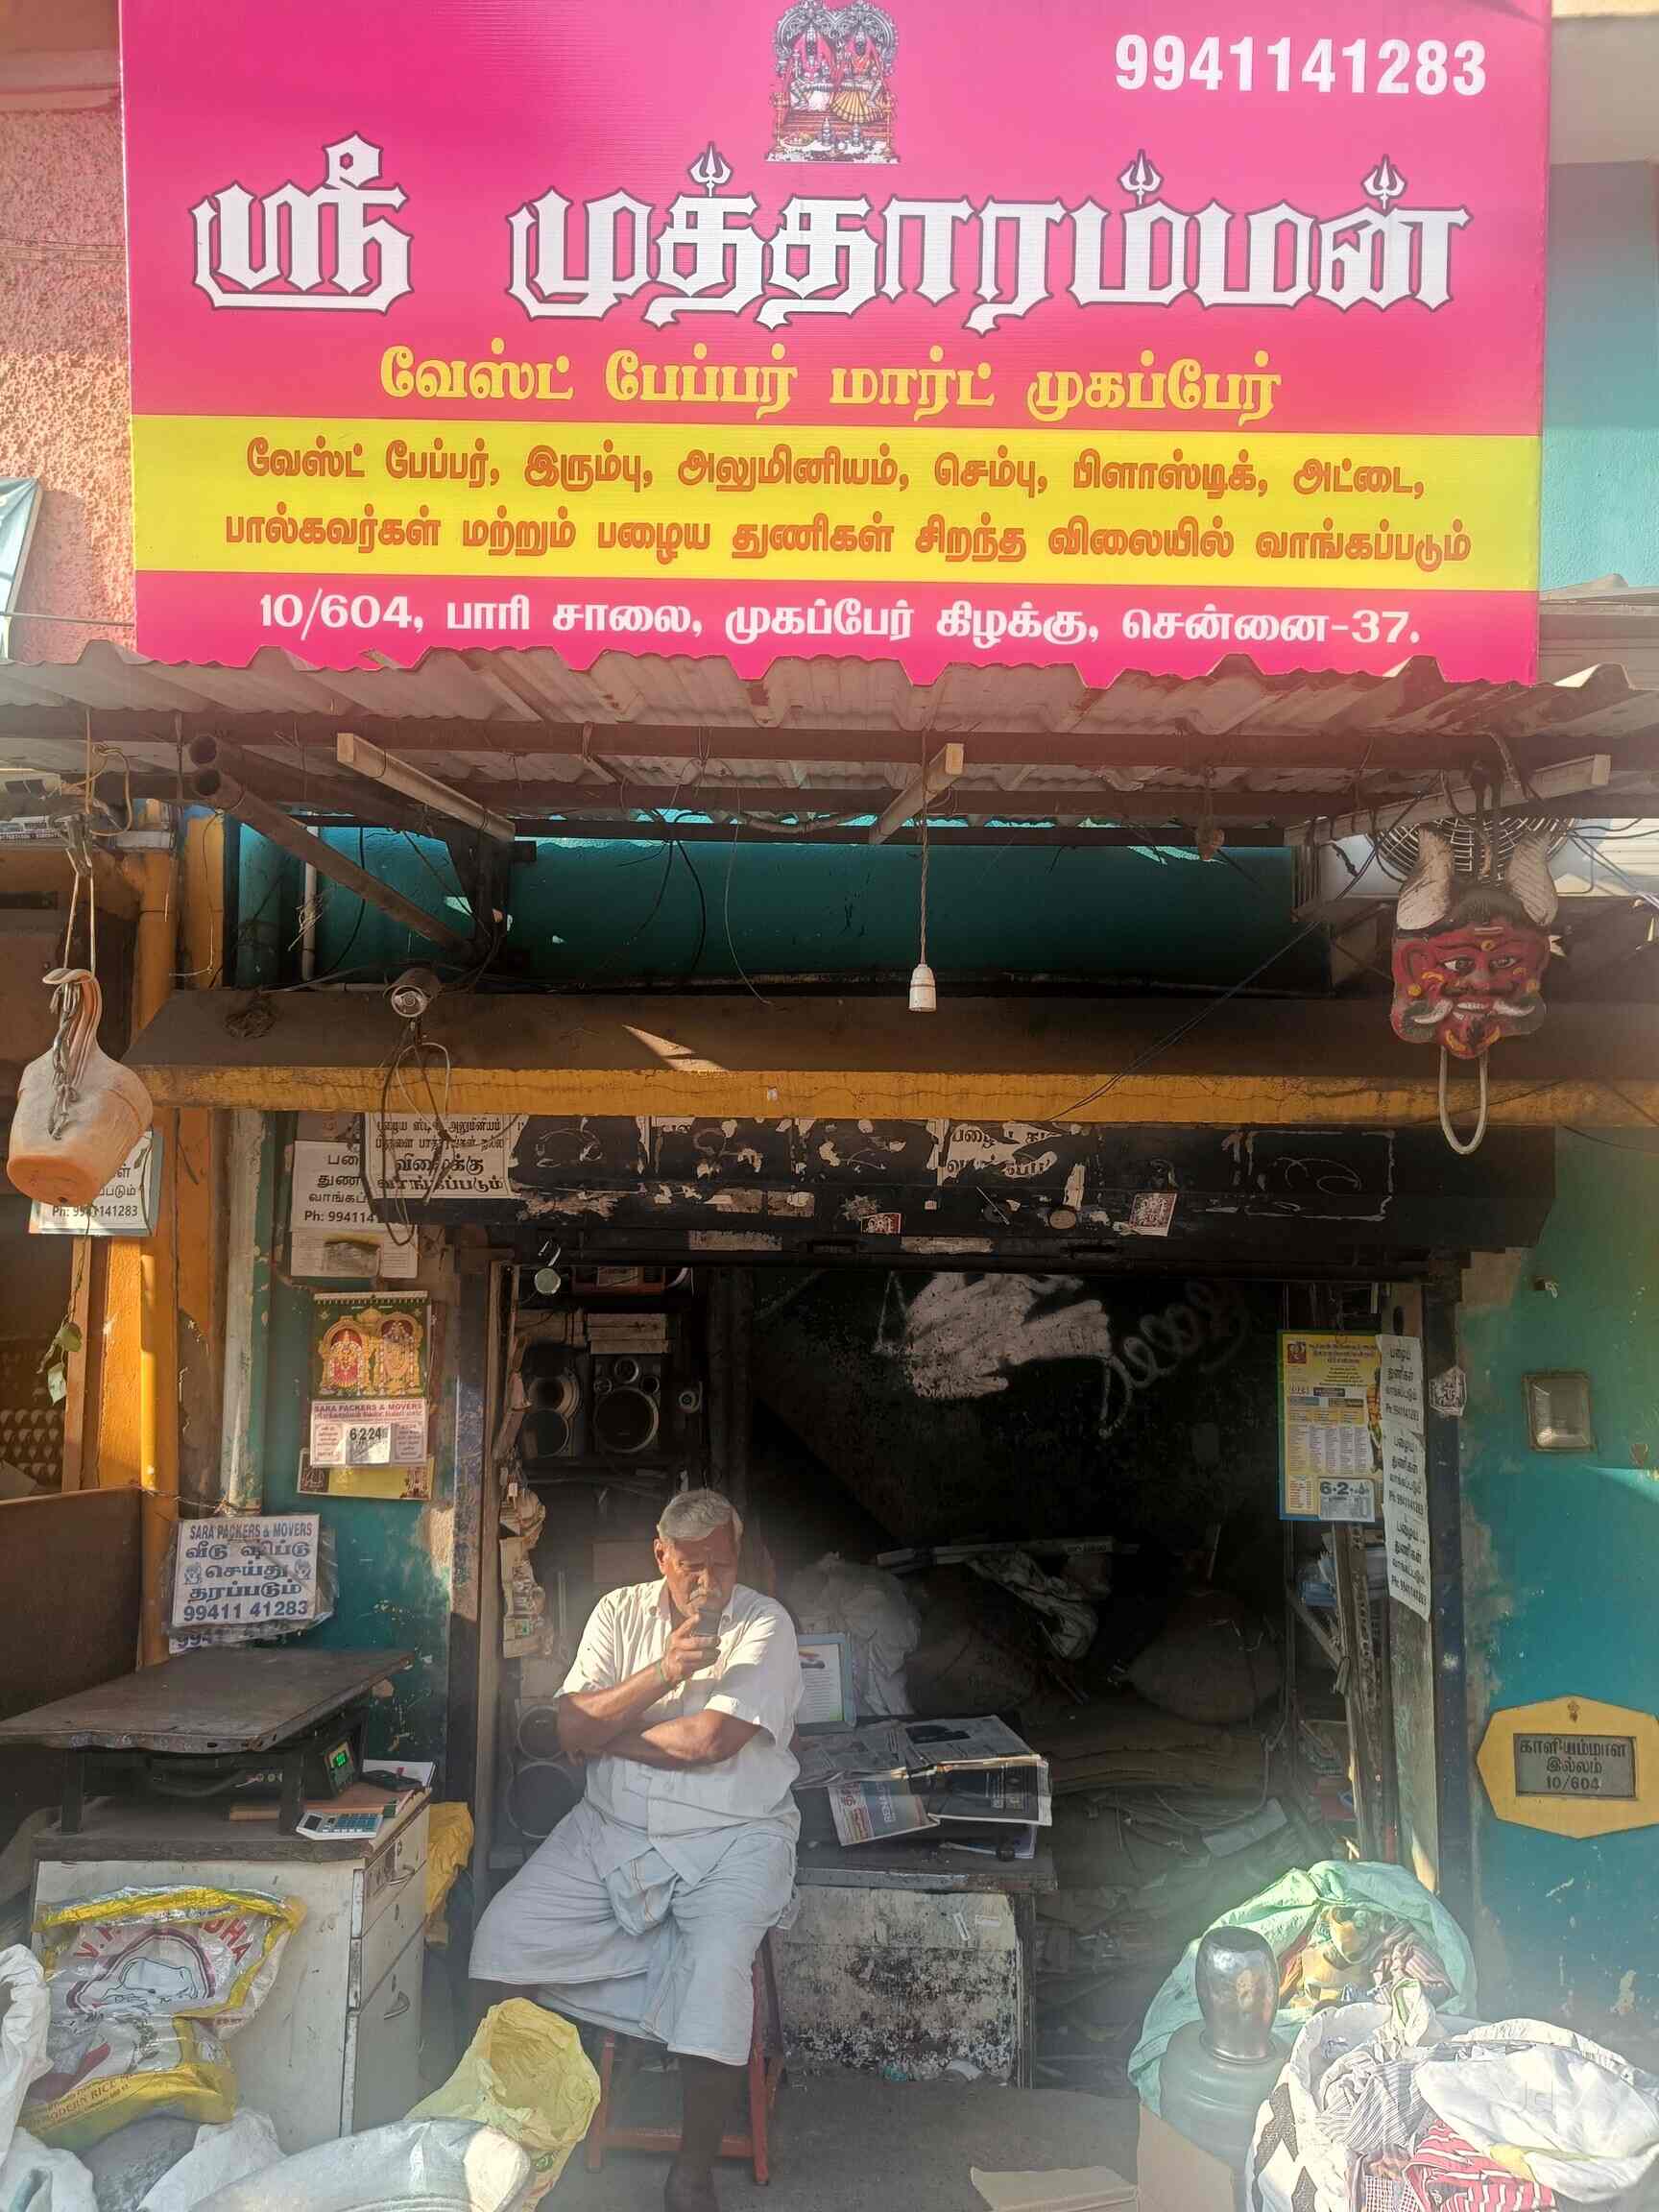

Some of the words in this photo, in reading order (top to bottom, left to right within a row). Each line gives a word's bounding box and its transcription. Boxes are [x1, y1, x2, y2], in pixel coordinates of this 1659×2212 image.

[1114, 34, 1486, 96] 9941141283
[506, 141, 1473, 337] முத்தாரம்மன்
[381, 338, 573, 401] வேஸ்ட்
[605, 343, 798, 420] பேப்பர்
[830, 345, 995, 421] மார்ட்
[1026, 349, 1282, 426] முகப்பேர்
[246, 436, 365, 479] வேஸ்ட்
[386, 438, 500, 488] பேப்பர்,
[524, 440, 655, 493] இரும்பு,
[678, 443, 910, 492] அலுமினியம்,
[934, 445, 1048, 498] செம்பு,
[1072, 448, 1268, 499] பிளாஸ்டிக்,
[1293, 458, 1425, 499] அட்டை,
[226, 504, 441, 554] பால்கவர்கள்
[462, 505, 576, 557] மற்றும்
[597, 520, 710, 565] பழைய
[732, 510, 894, 559] துணிகள்
[915, 512, 1026, 563] சிறந்த
[1048, 516, 1234, 559] விலையில்
[1255, 518, 1471, 571] வாங்கப்படும்
[260, 588, 423, 641] 10/604,
[445, 593, 530, 631] பாரி
[552, 602, 703, 637] சாலை,
[725, 597, 913, 645] முகப்பேர்
[936, 601, 1098, 650] கிழக்கு,
[1121, 602, 1420, 645] சென்னை-37.
[305, 1211, 325, 1222] Ph:
[190, 1525, 214, 1540] SARA
[217, 1524, 261, 1540] PACKERS
[273, 1522, 312, 1537] MOVERS
[183, 1603, 241, 1622] 99411
[250, 1600, 308, 1617] 41283
